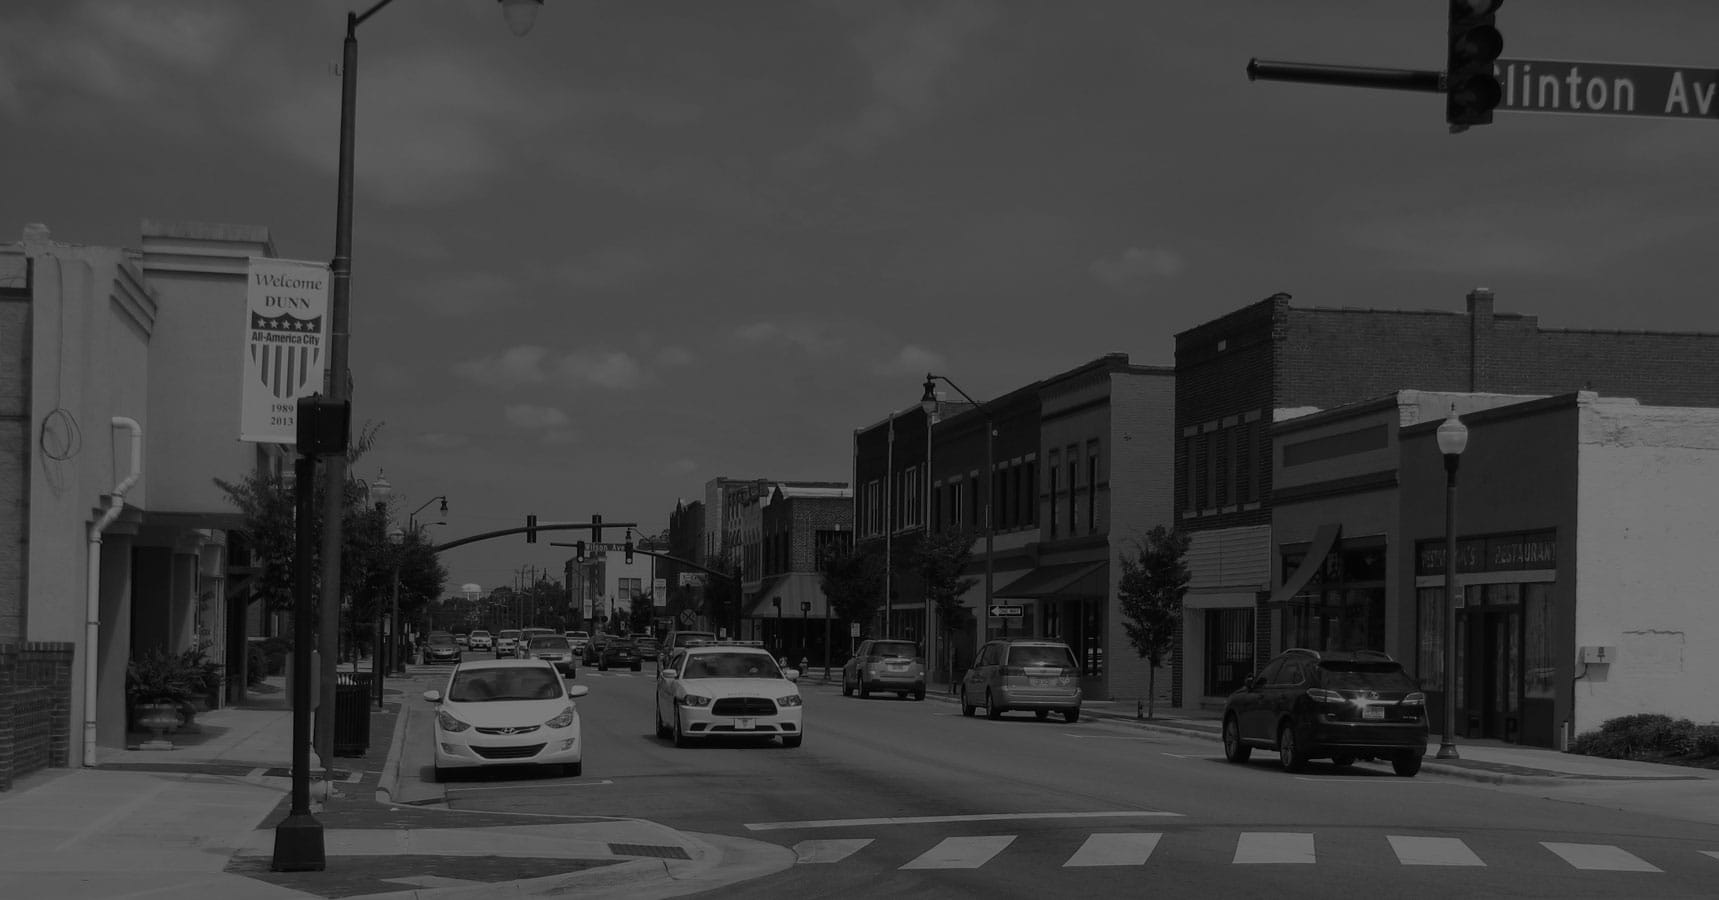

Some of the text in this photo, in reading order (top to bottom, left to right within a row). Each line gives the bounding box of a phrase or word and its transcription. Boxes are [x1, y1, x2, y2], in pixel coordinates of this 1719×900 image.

[1493, 63, 1635, 111] linton
[256, 273, 322, 290] Welcome
[265, 295, 311, 309] DUNN
[251, 331, 321, 346] All-America City
[271, 404, 294, 413] 1989
[271, 416, 294, 426] 2013
